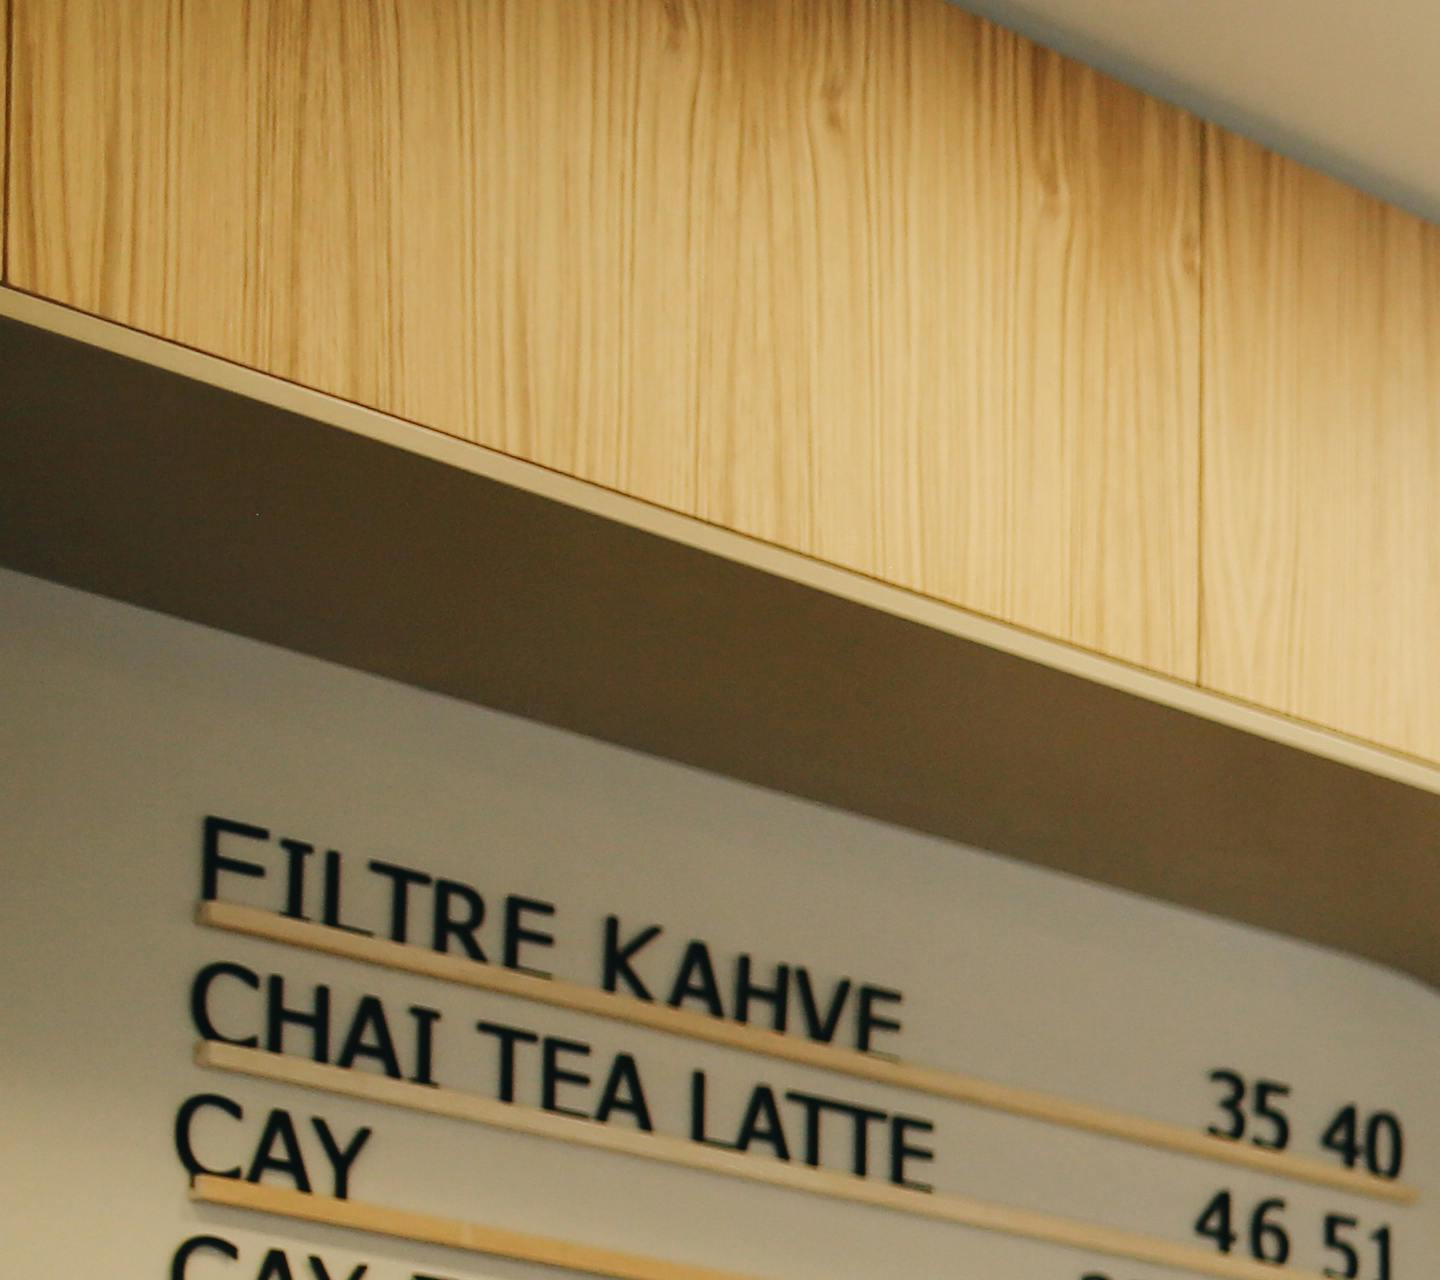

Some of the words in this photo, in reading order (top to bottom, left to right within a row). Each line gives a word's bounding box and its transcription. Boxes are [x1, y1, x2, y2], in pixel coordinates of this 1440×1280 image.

[190, 962, 442, 1086] CHAI
[478, 1022, 653, 1132] TEA
[691, 1071, 935, 1194] LATTE
[1194, 1188, 1291, 1267] 46
[202, 816, 555, 979] FILTRE
[602, 914, 903, 1062] KAHVE
[1207, 1067, 1291, 1151] 35
[1321, 1102, 1403, 1180] 40
